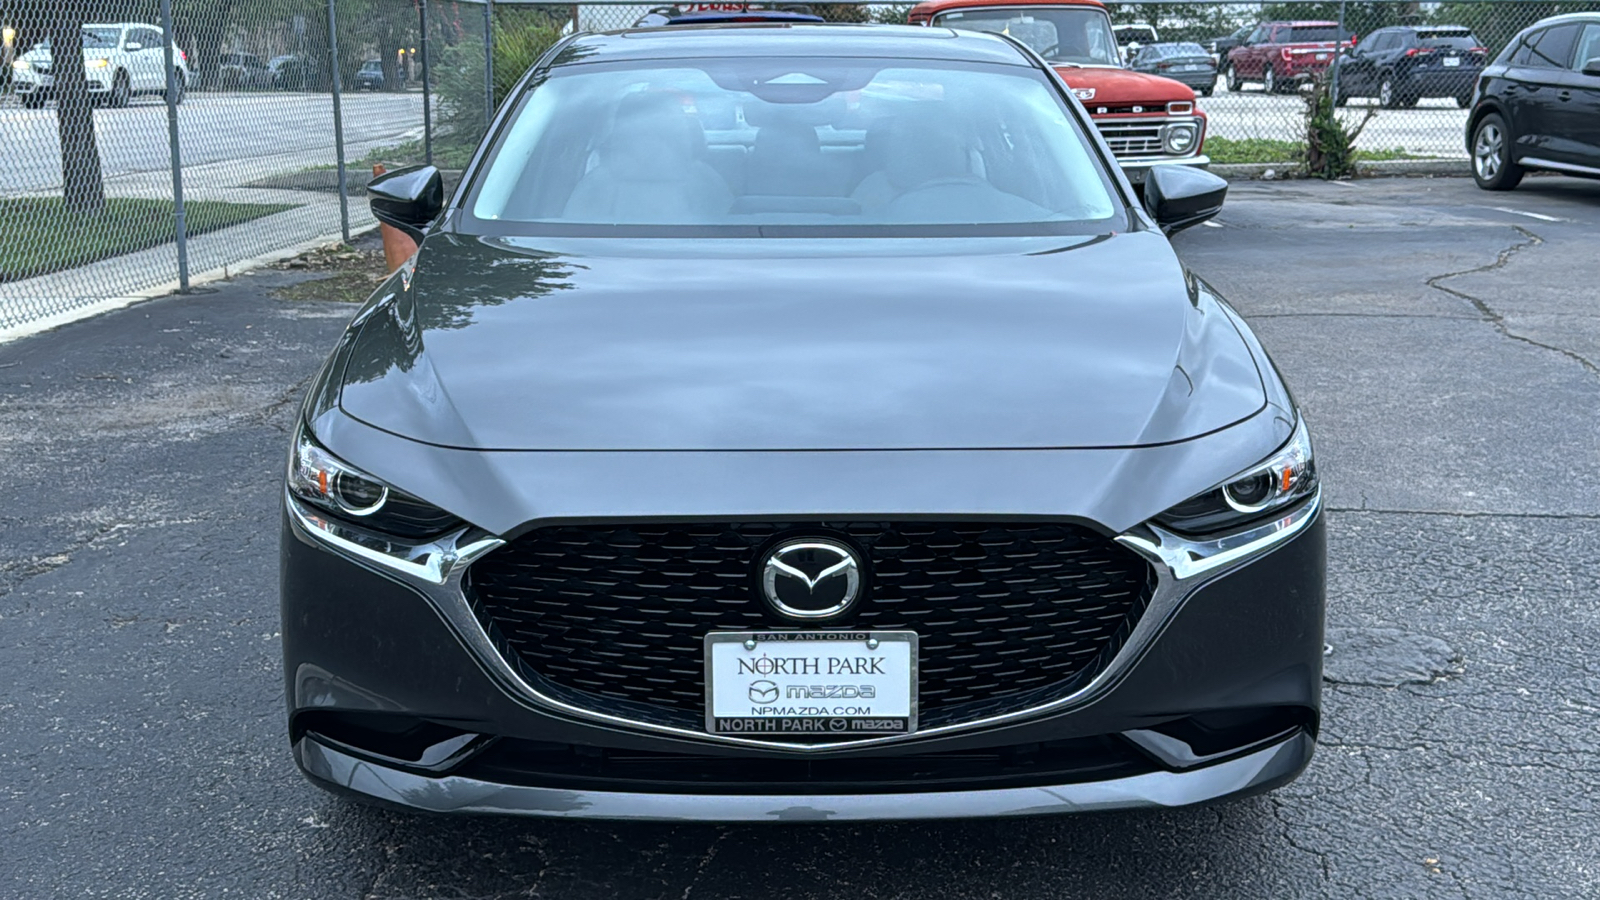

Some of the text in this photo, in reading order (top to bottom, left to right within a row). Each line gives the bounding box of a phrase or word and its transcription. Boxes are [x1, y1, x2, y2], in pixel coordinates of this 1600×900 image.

[756, 633, 789, 641] SAN
[736, 657, 886, 675] NORTH PARK
[786, 684, 876, 699] mazda
[751, 706, 871, 716] NPMAZDA.COM
[719, 719, 904, 731] NORTH PARK mazda
